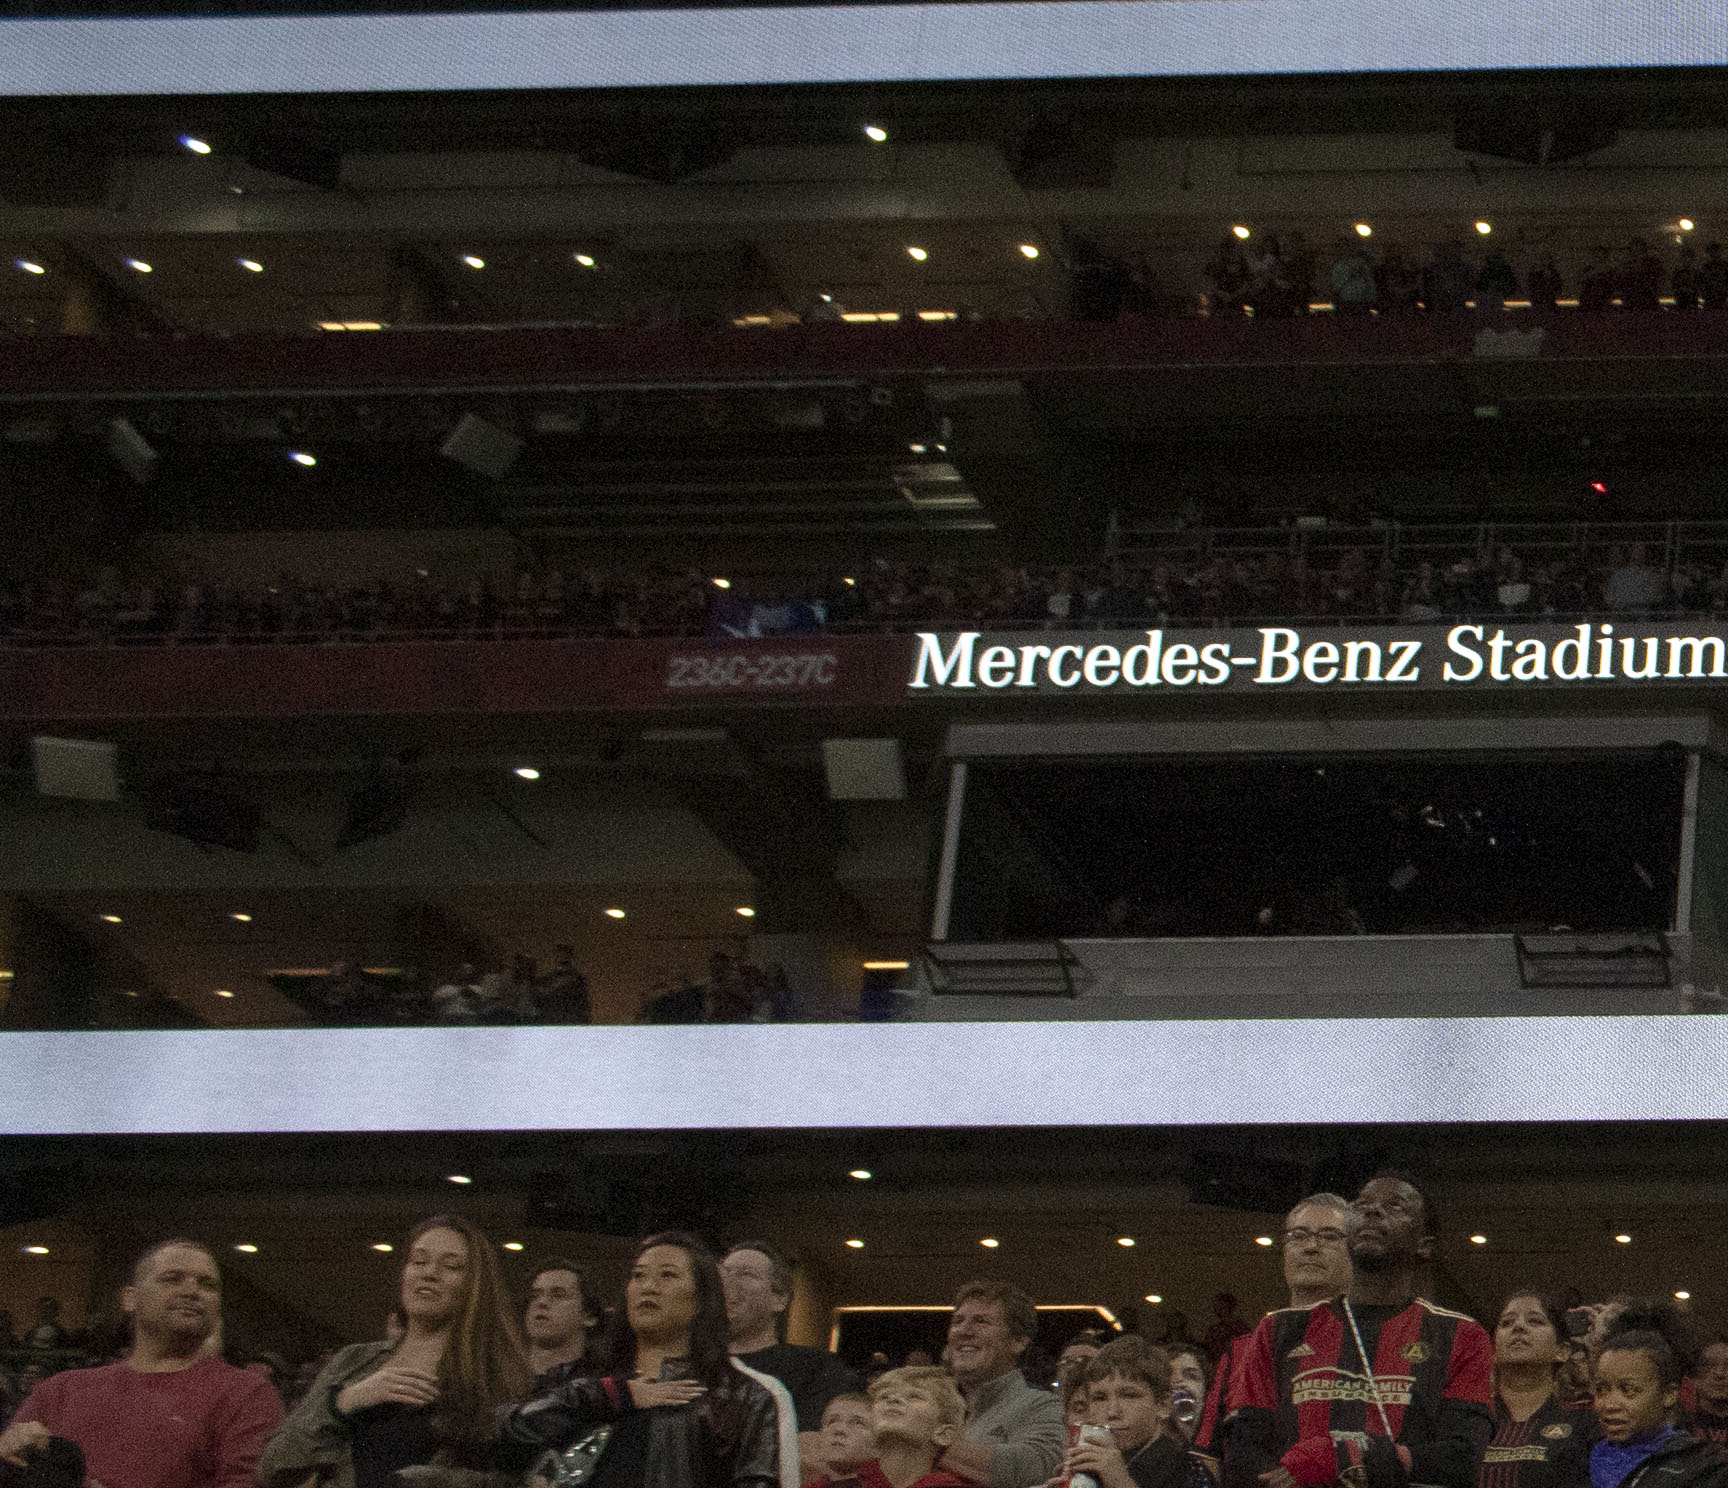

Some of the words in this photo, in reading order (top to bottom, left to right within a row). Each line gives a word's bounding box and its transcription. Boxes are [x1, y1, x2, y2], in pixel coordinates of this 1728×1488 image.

[667, 654, 837, 688] 236C-237C
[908, 627, 1422, 688] Mercedes-Benz
[1442, 623, 1728, 684] Stadium
[1293, 1379, 1360, 1391] AMERICAN
